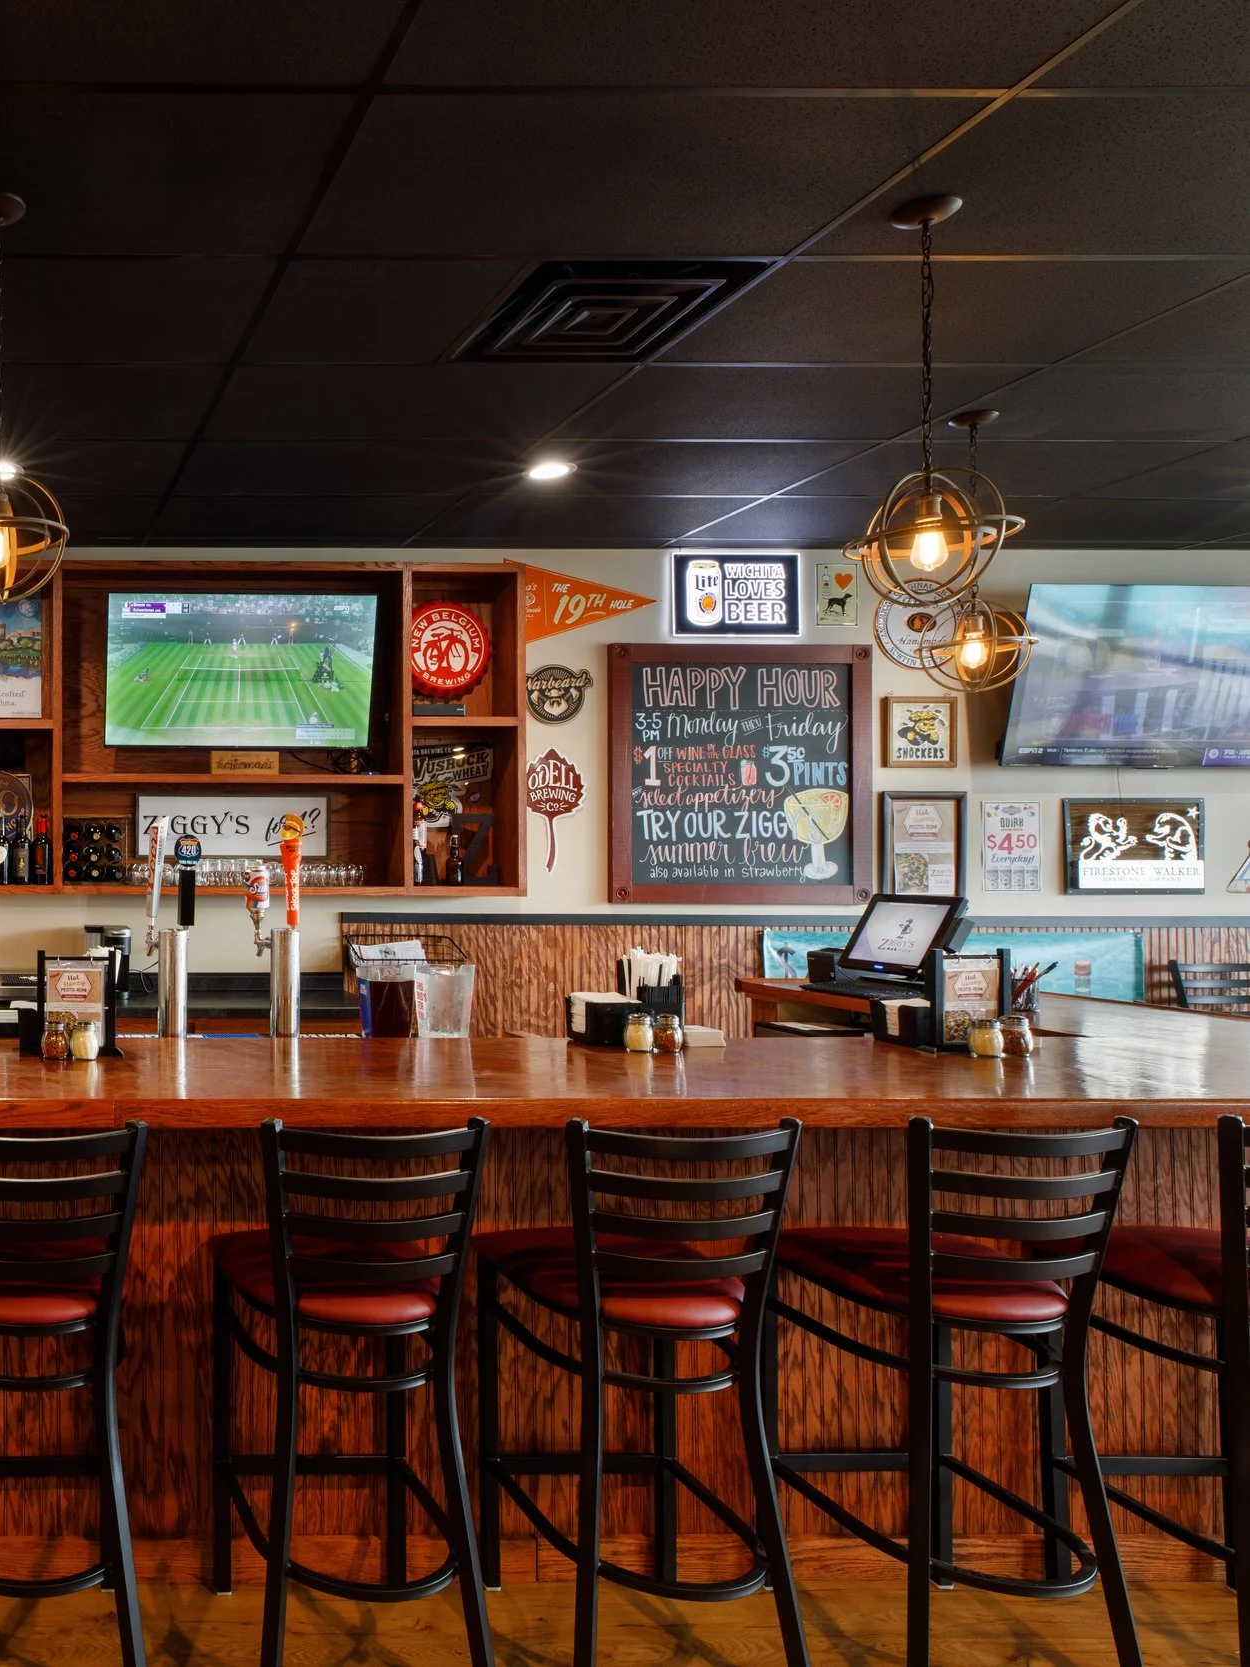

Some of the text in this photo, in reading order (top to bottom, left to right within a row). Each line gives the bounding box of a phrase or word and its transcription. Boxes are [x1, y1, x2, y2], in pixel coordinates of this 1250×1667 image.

[725, 564, 784, 578] WICHITA
[551, 583, 570, 593] THE
[695, 574, 719, 591] Lite
[726, 580, 784, 598] LOVES
[553, 593, 607, 624] 19TH
[610, 599, 634, 609] HOLE
[726, 601, 785, 623] BEER
[411, 611, 481, 648] NEW BELGIUM
[888, 646, 917, 666] AUSTIN
[422, 672, 471, 685] BREWING
[642, 665, 841, 710] HAPPY HOUR
[635, 712, 662, 730] 3-5
[642, 730, 660, 742] PM
[667, 711, 849, 754] Monday THRU Friday
[657, 746, 674, 760] OFF
[676, 746, 707, 760] WINE
[722, 744, 757, 760] GLASS
[896, 747, 945, 759] SHOCKERS
[452, 765, 487, 780] WHEAT
[528, 760, 577, 791] ODELL
[663, 761, 728, 774] SPECIALTY
[793, 761, 848, 786] PINTS
[668, 773, 736, 787] COCKTAILS
[529, 788, 577, 803] BREWING
[635, 785, 687, 809] select
[686, 783, 784, 812] appetizers
[142, 811, 251, 835] ZGGY'S
[636, 810, 822, 842] TRY OUR ZIGGY'S
[181, 845, 197, 855] 420
[639, 837, 812, 866] summer brew
[991, 853, 1035, 866] Everyday!
[650, 865, 806, 883] also available in strawberry
[1083, 867, 1200, 876] FIRESTONE WALKER
